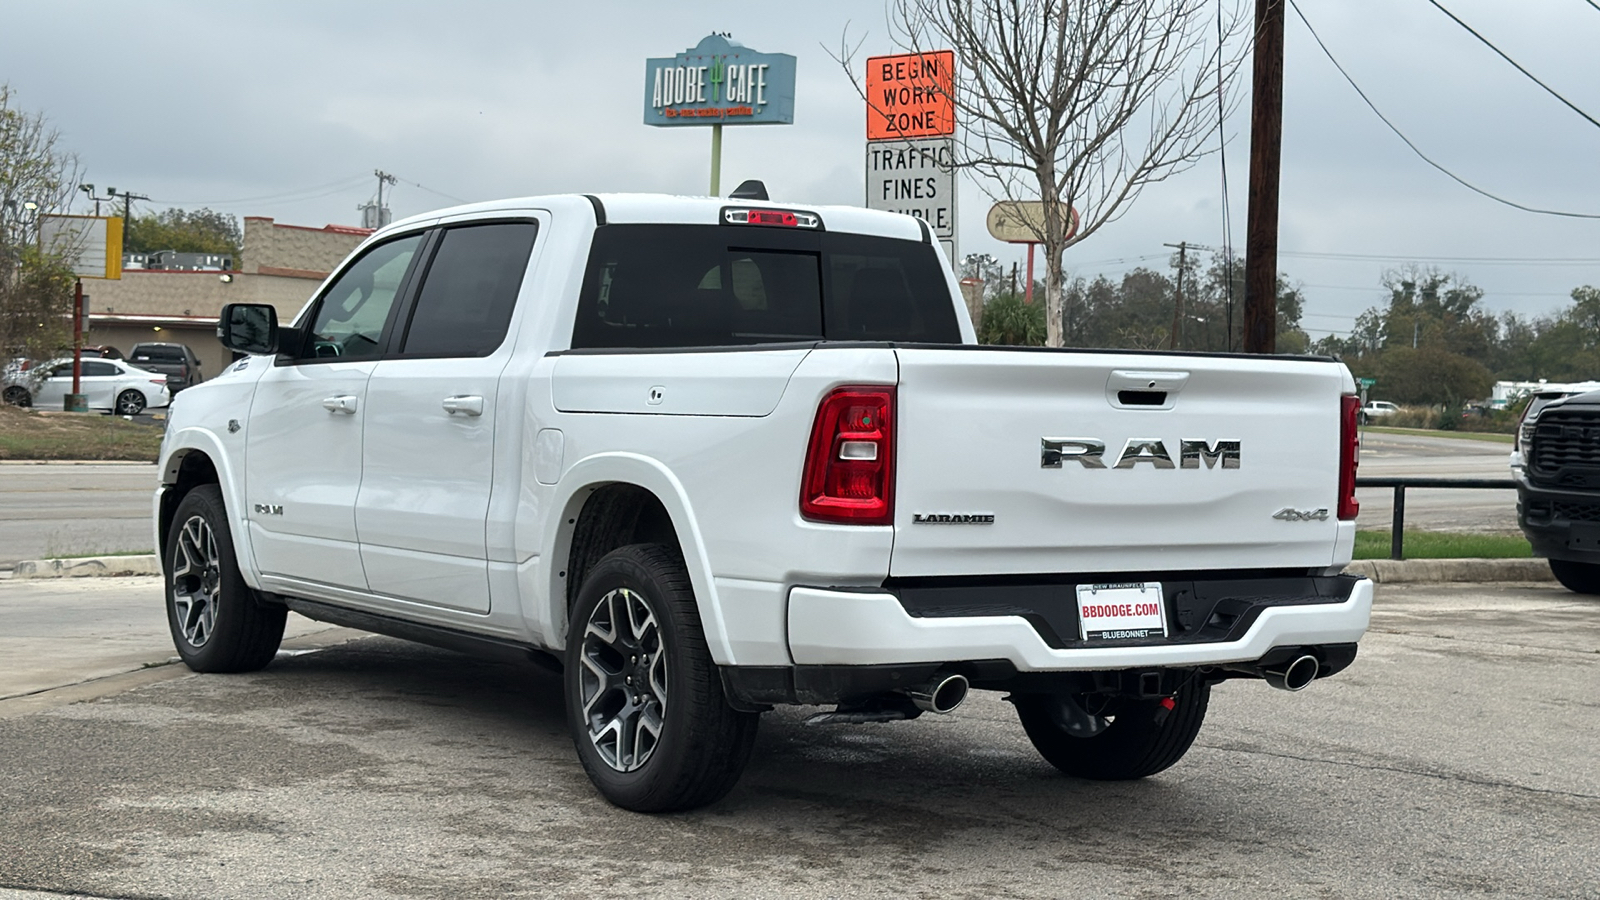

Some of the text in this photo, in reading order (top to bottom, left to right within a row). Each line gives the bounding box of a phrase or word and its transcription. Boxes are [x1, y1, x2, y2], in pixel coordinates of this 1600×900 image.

[882, 60, 938, 81] BEGIN
[653, 64, 769, 108] ADOBE CAFE
[883, 85, 937, 107] WORK
[886, 111, 936, 132] ZONE
[872, 147, 949, 171] TRAFFIC
[883, 178, 936, 200] FINES
[1040, 436, 1242, 470] RAM
[912, 513, 995, 525] LARAMIE
[1082, 603, 1159, 618] BBDODGE.COM
[1102, 630, 1148, 639] BLUEBONNET
